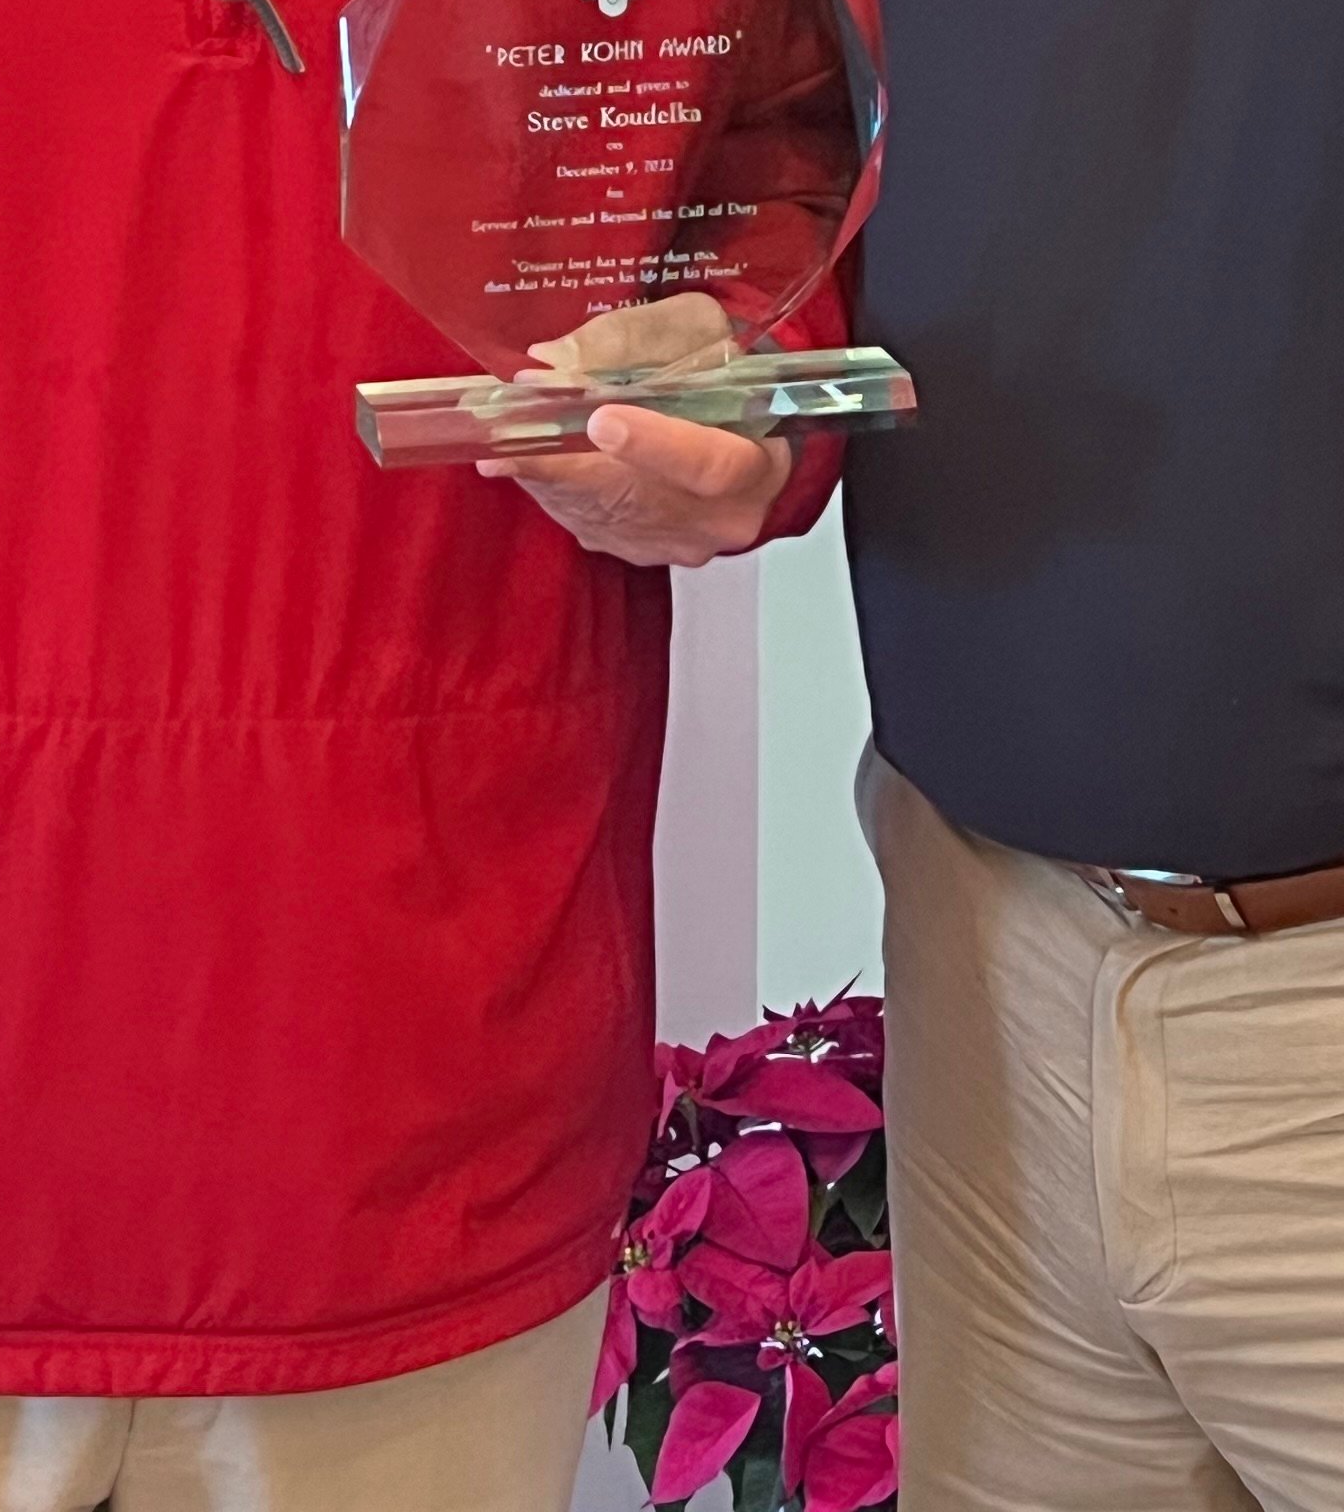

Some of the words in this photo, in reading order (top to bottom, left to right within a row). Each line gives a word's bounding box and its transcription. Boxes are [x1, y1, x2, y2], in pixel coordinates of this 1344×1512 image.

[581, 40, 644, 63] KOHN
[527, 111, 589, 133] Steve
[600, 102, 702, 128] Koudelka
